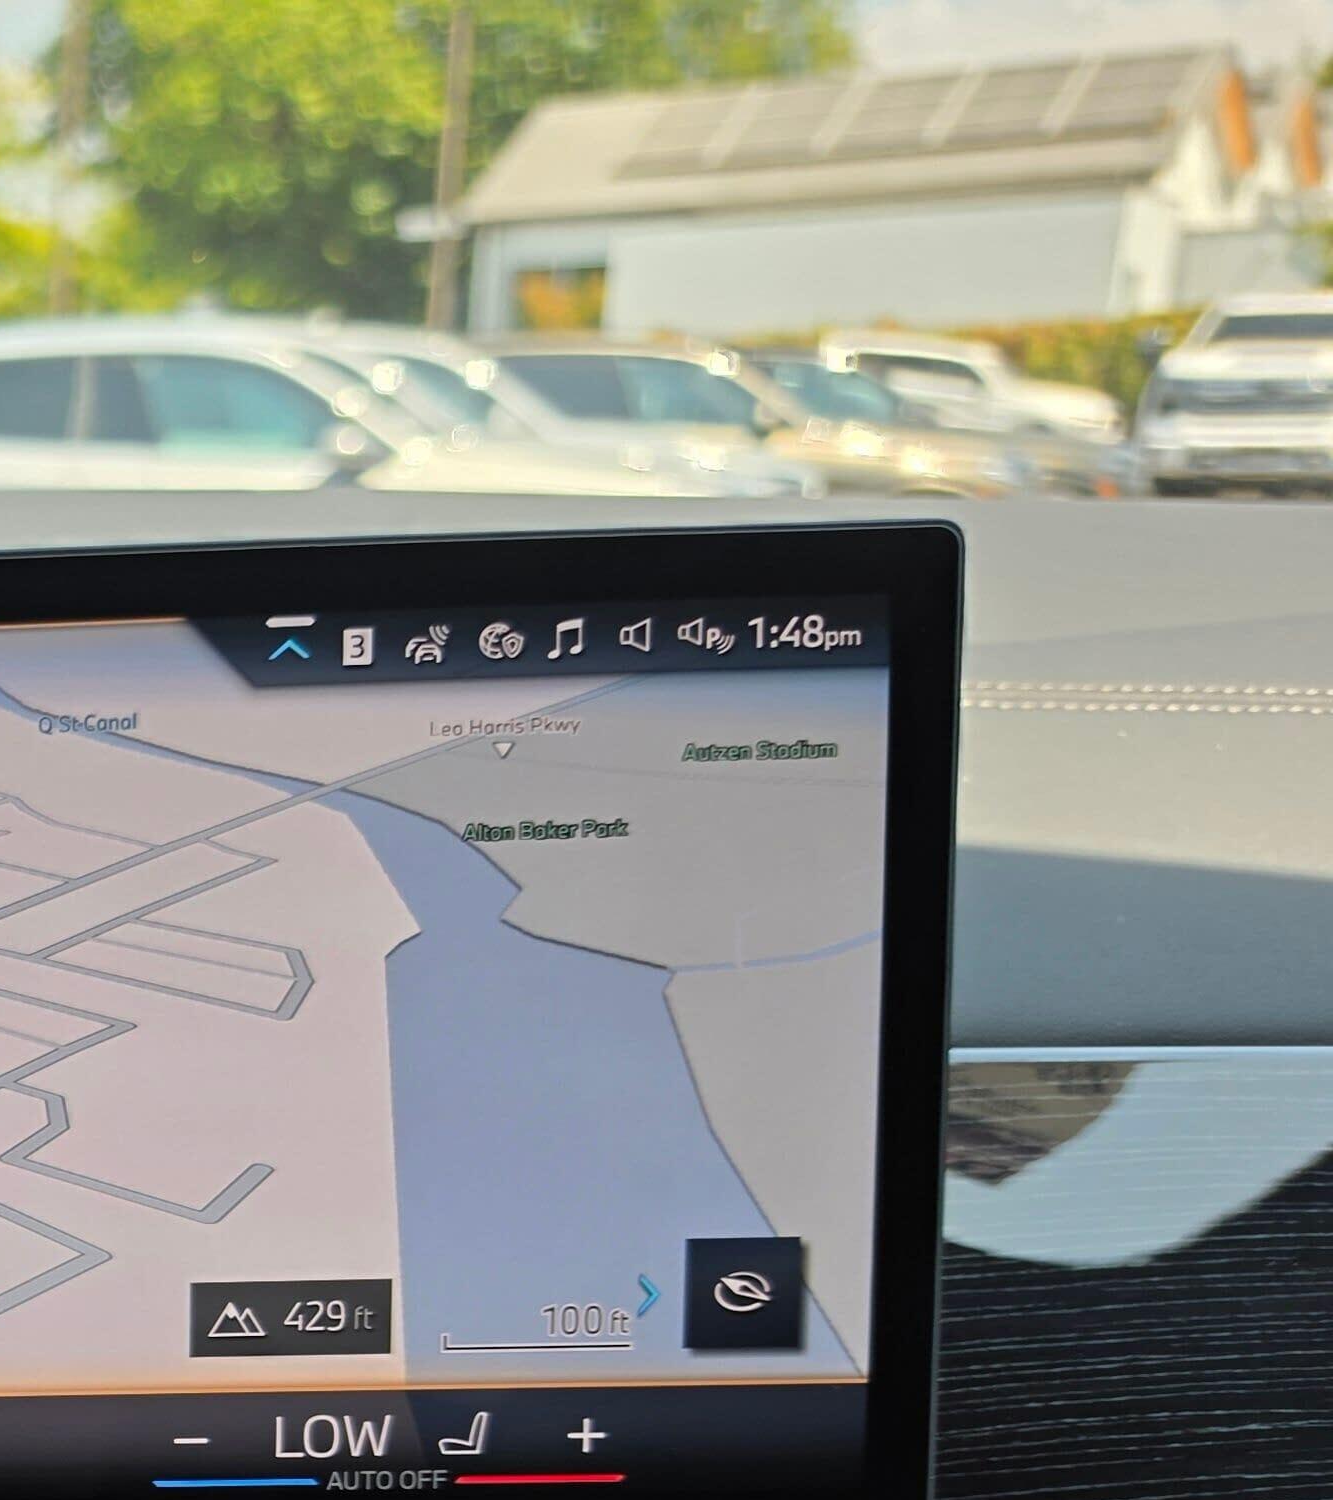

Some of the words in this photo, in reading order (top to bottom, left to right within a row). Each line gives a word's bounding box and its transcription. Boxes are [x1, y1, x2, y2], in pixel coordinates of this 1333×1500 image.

[348, 633, 367, 660] 3
[747, 614, 863, 654] 1:48pm
[37, 715, 54, 735] Q
[83, 711, 139, 733] Canal
[429, 721, 464, 738] Leo
[469, 719, 525, 737] Harris
[530, 716, 582, 736] Pkwy
[681, 742, 753, 763] Autzen
[755, 740, 839, 760] Stadium
[462, 822, 515, 843] Alton
[518, 820, 579, 842] Baker
[581, 818, 630, 839] Park
[282, 1300, 347, 1333] 429
[352, 1303, 375, 1331] ft
[540, 1304, 604, 1338] 100
[607, 1308, 631, 1337] ft
[273, 1413, 395, 1459] LOW
[325, 1469, 394, 1492] AUTO
[398, 1468, 449, 1491] OFF
